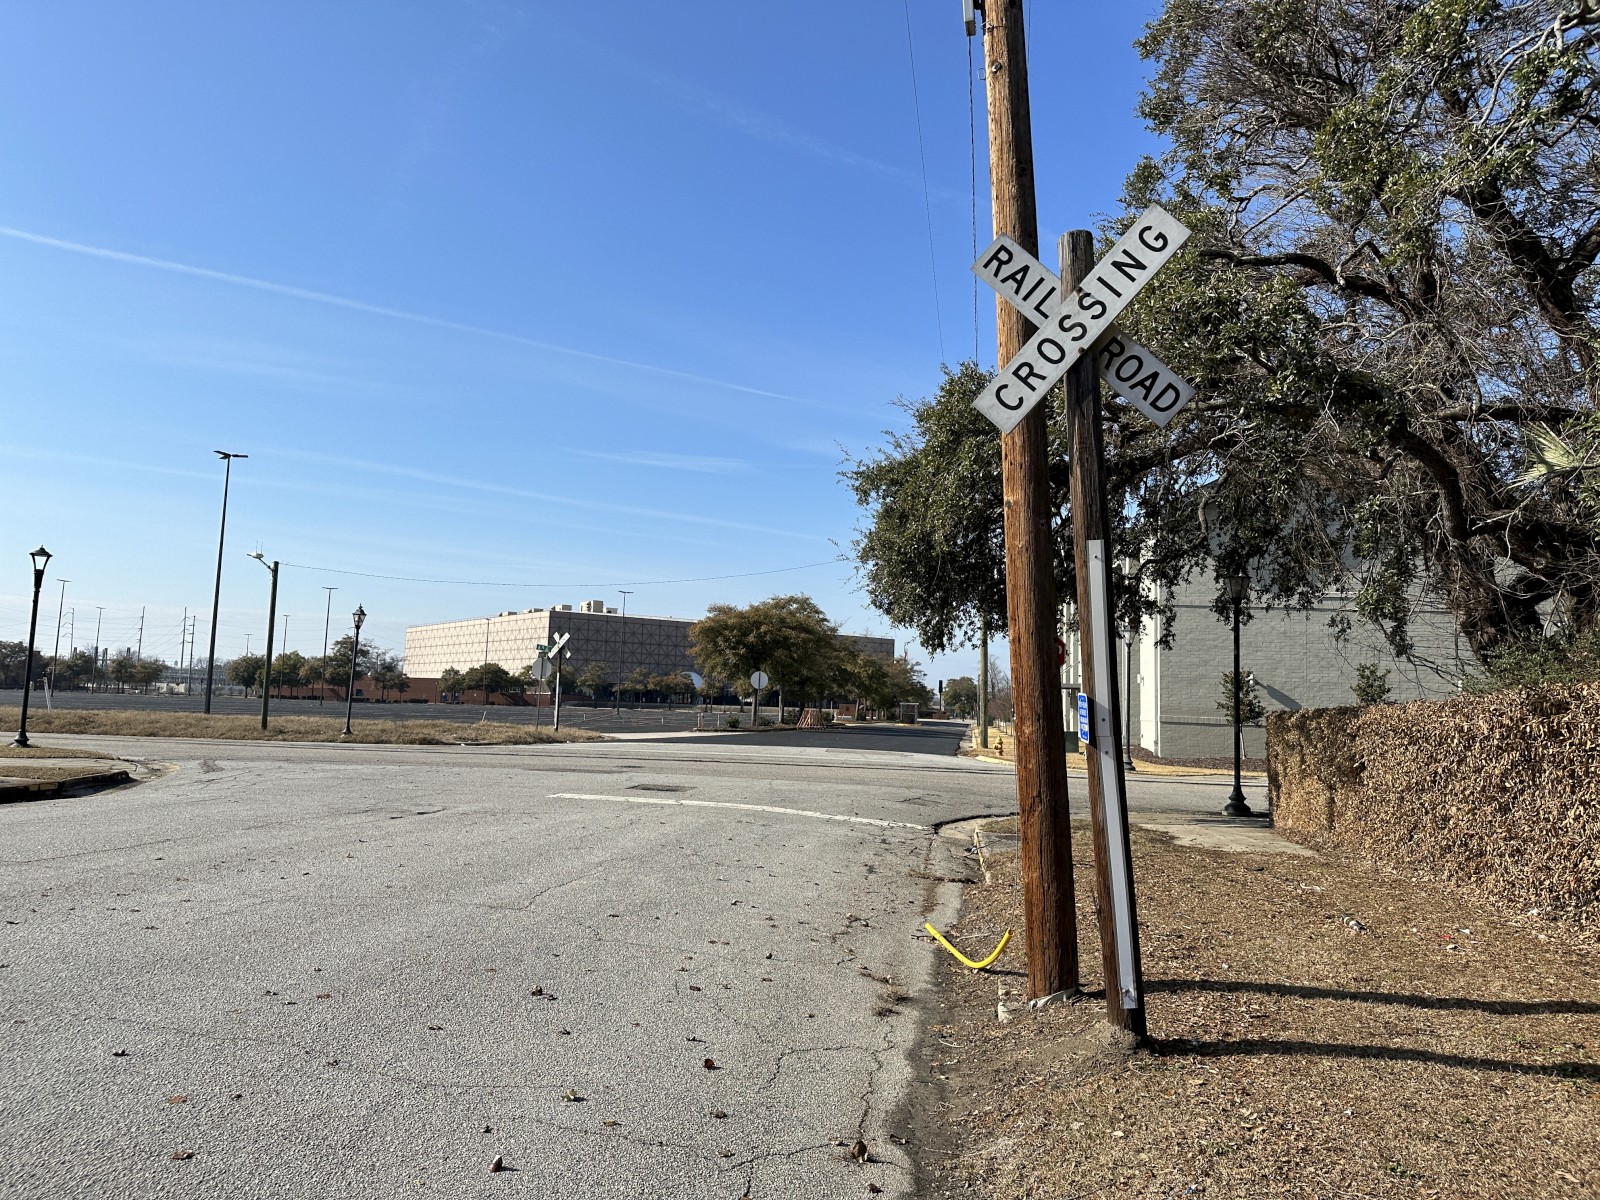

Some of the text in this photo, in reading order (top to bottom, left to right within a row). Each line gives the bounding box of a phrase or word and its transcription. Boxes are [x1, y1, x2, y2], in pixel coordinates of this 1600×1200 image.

[982, 244, 1181, 413] RAIL ROAD
[995, 225, 1169, 411] CROSSING
